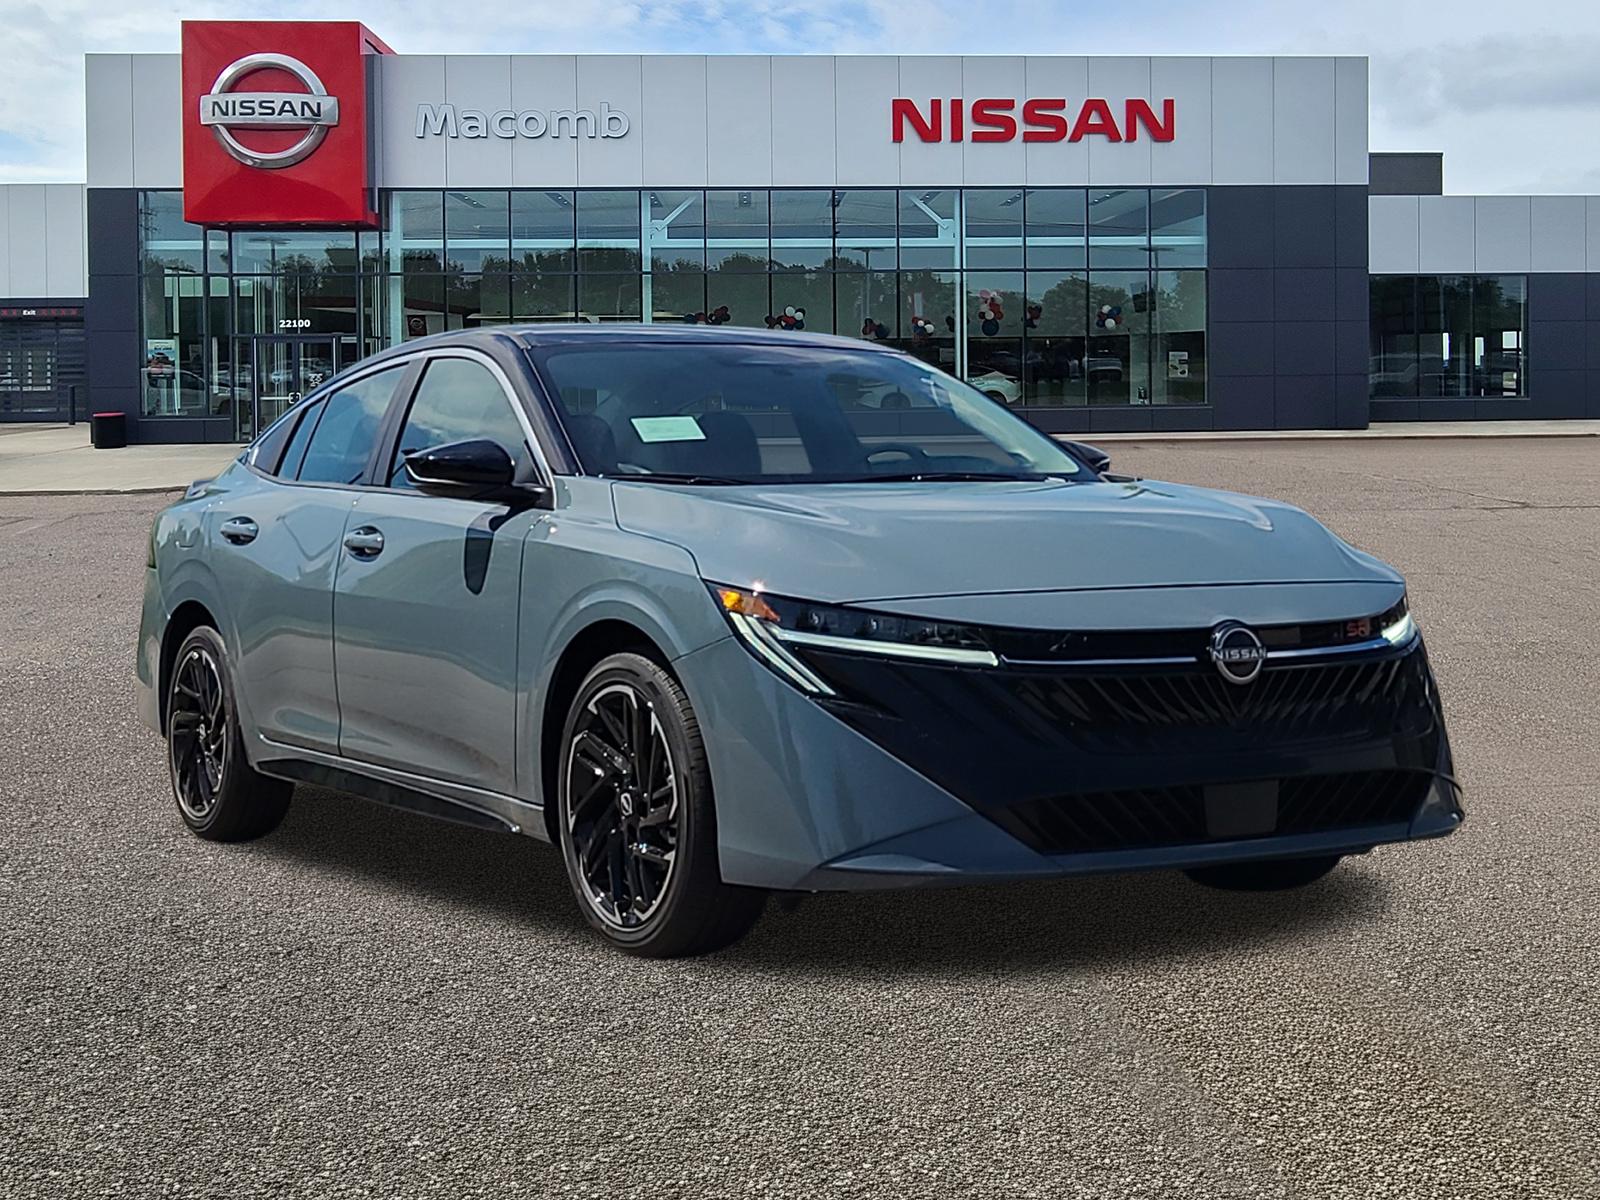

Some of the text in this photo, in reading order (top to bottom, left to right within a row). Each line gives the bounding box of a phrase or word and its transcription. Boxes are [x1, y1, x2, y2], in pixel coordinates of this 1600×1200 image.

[212, 100, 321, 117] NISSAN
[415, 102, 630, 139] Macomb
[892, 98, 1175, 143] NISSAN
[279, 319, 311, 328] 22100
[1211, 648, 1267, 661] NISSAN
